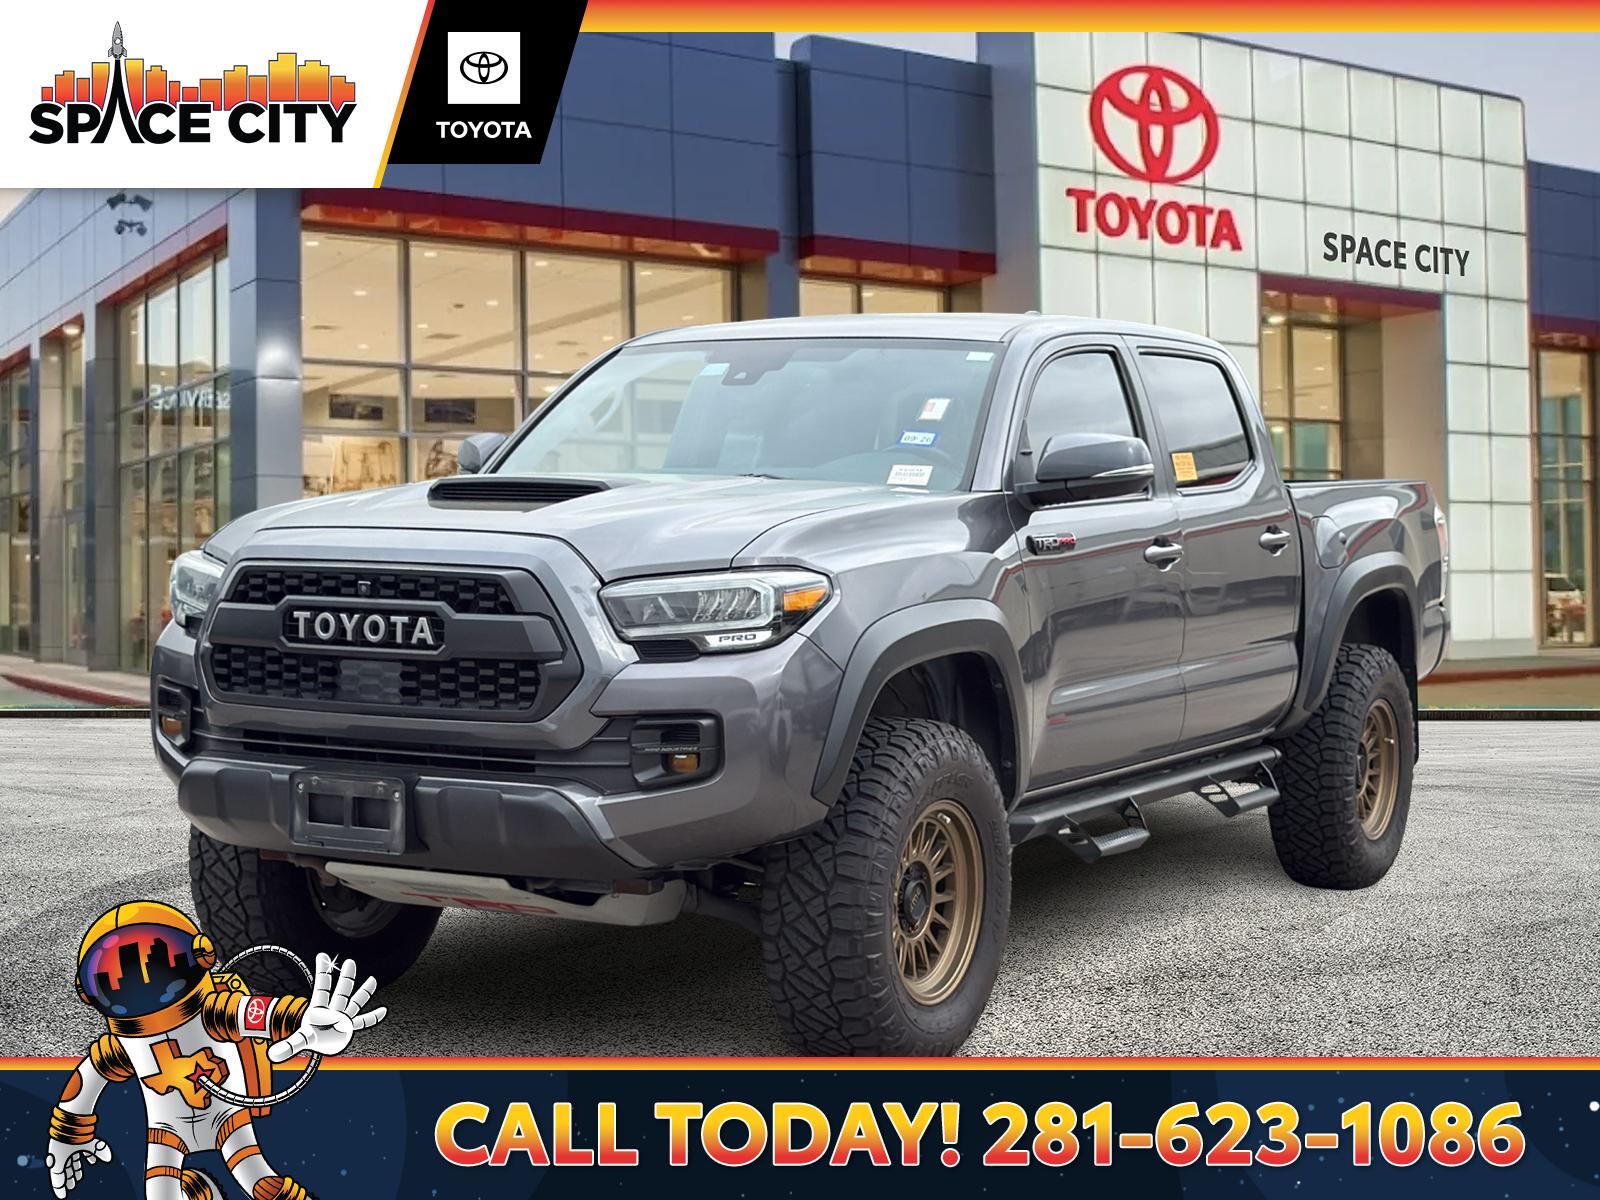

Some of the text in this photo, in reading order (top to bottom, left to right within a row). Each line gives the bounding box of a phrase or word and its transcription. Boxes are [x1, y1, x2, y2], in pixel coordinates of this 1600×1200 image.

[1066, 188, 1243, 251] TOYOTA
[1323, 231, 1470, 277] SPACE CITY
[293, 610, 435, 646] TOYOTA
[718, 633, 757, 643] PRO
